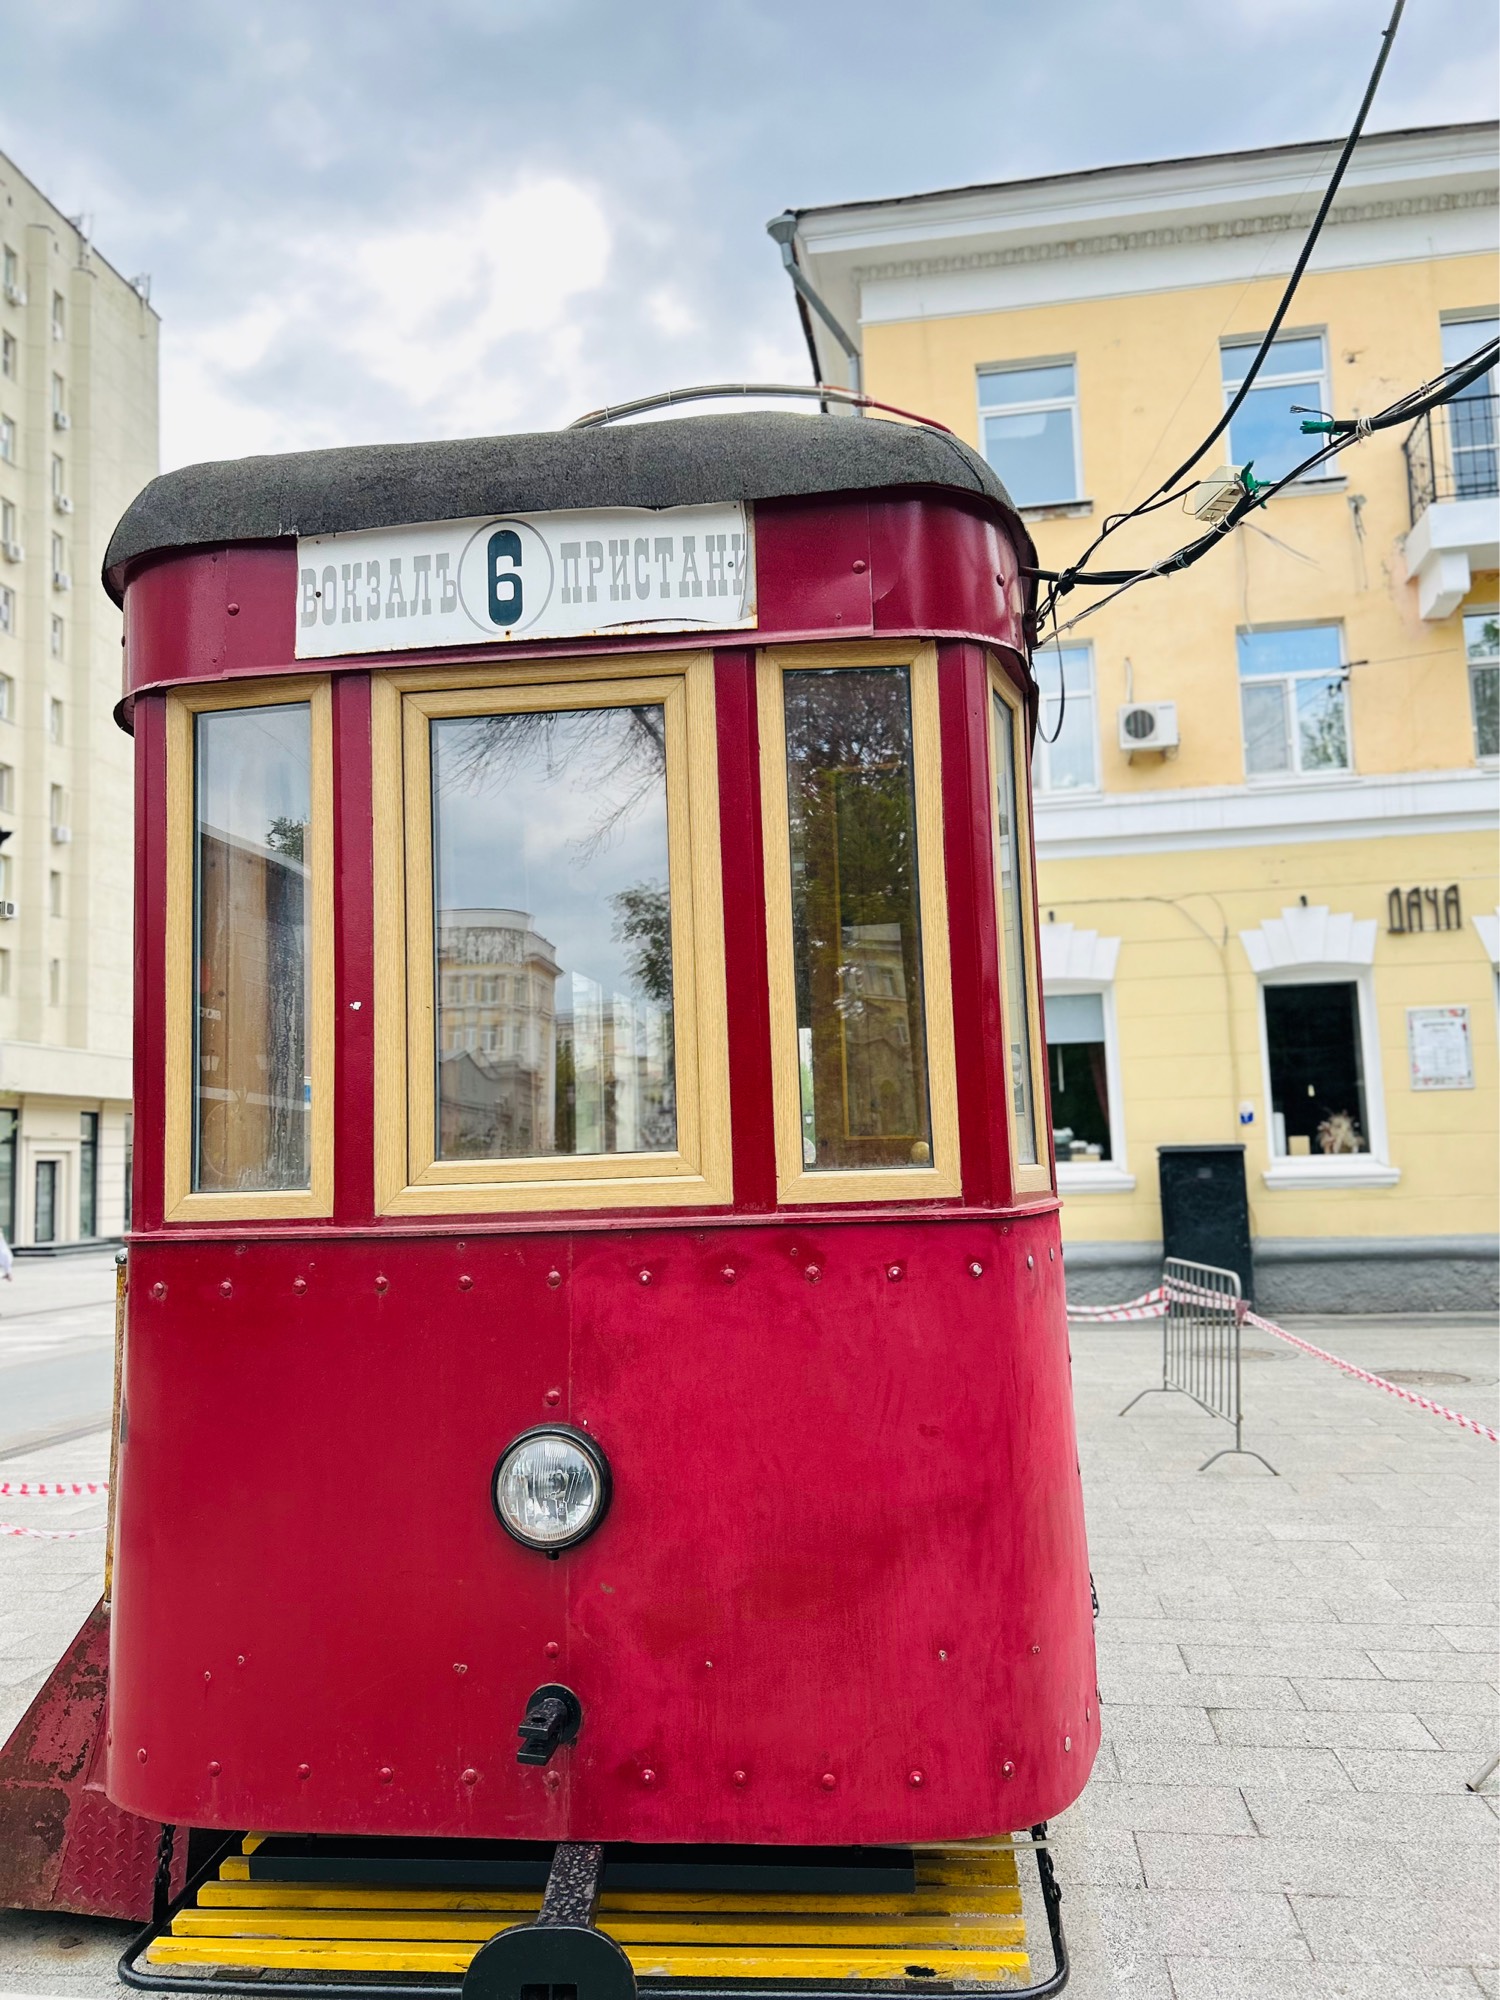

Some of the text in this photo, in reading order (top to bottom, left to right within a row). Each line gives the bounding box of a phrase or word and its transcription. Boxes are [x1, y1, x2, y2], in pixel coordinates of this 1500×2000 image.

[300, 553, 458, 628] ВОКЗАЛЪ
[487, 530, 523, 627] 6
[1387, 884, 1461, 934] ДАЧА
